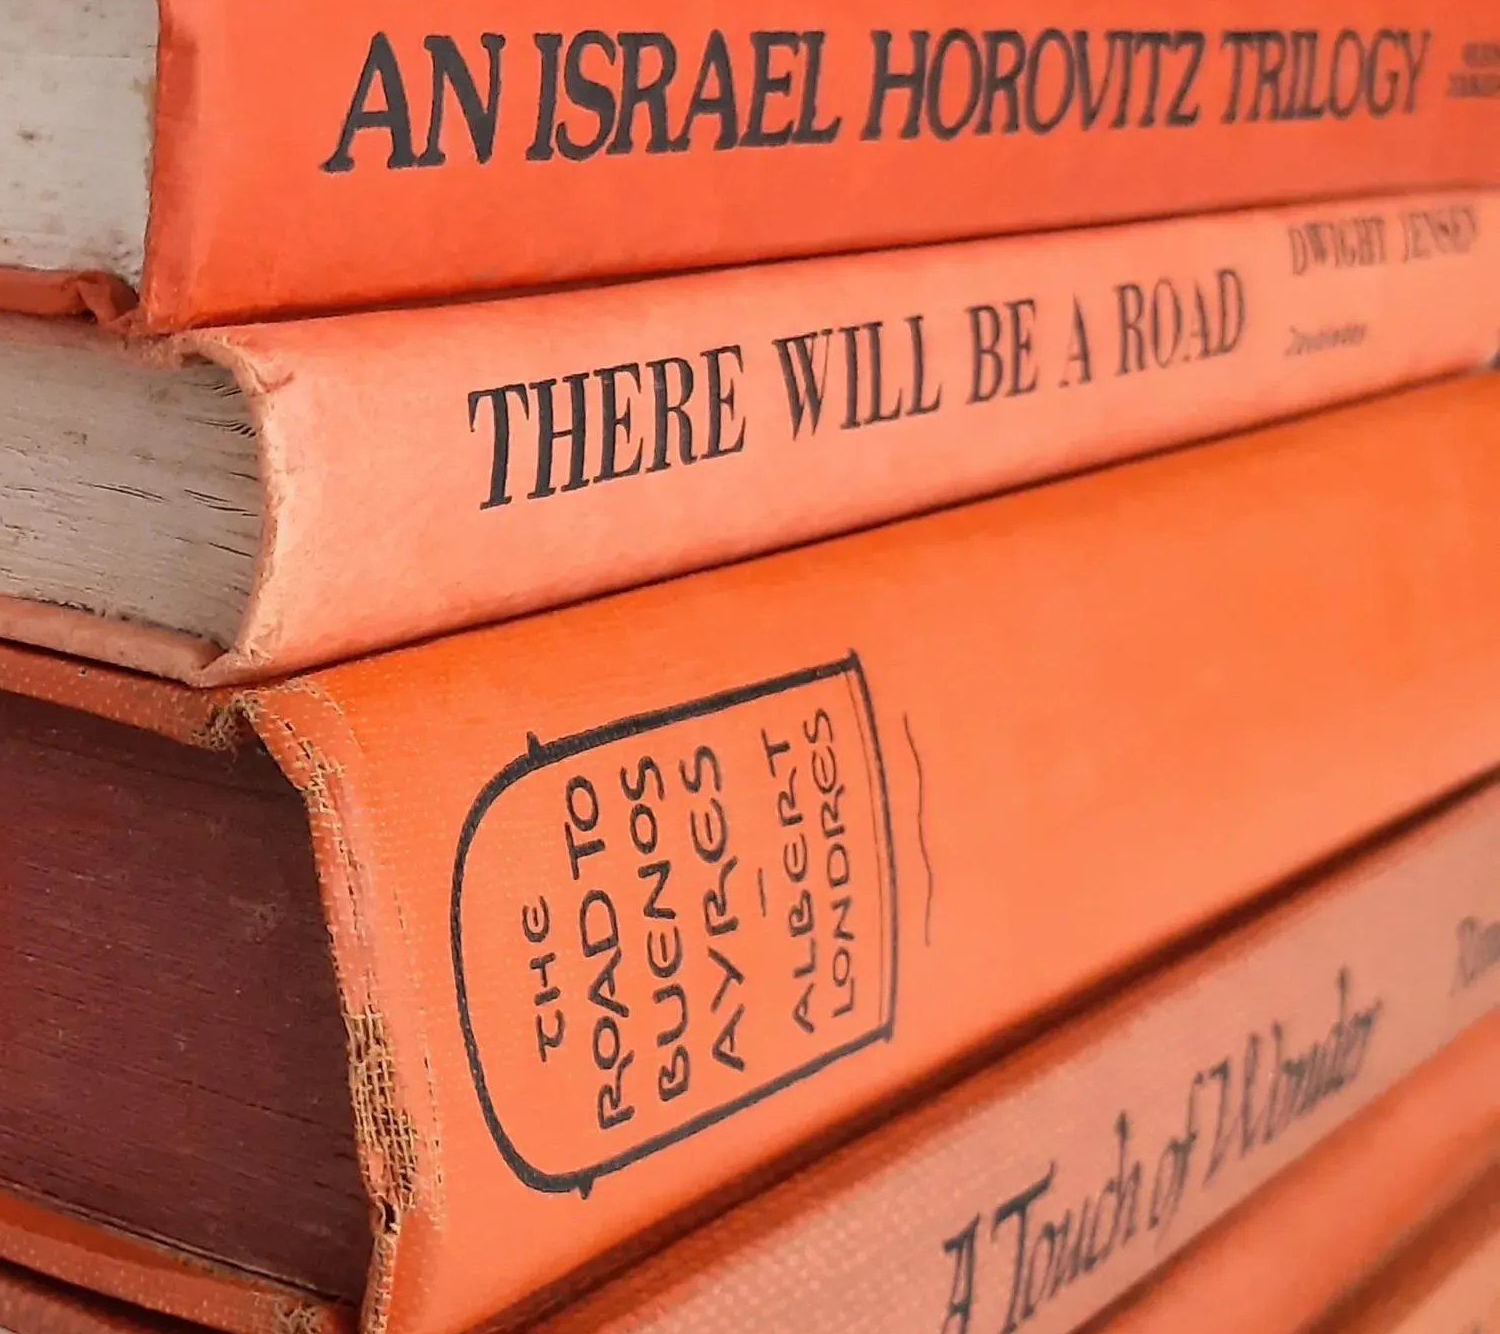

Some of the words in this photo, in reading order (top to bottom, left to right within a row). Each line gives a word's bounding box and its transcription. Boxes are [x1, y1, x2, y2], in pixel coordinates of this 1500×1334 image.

[318, 30, 506, 174] AN
[525, 29, 843, 162] ISRAEL
[860, 27, 1205, 141] HOROVITZ
[1220, 28, 1432, 124] TRILOGY
[1287, 215, 1389, 277] DWIGHT
[467, 344, 747, 511] THERE
[771, 315, 942, 442] WILL
[964, 299, 1040, 405] BE
[1058, 292, 1092, 389] A
[1114, 267, 1247, 376] ROAD
[564, 774, 607, 881] TO
[620, 754, 691, 1103] BUENOS
[680, 744, 745, 1072] AYRES
[761, 728, 817, 1034] ALBERT
[803, 707, 856, 1019] LONDRES
[522, 894, 566, 1062] THE
[579, 889, 635, 1131] ROAD
[1148, 1072, 1204, 1250] of
[1203, 963, 1382, 1185] Wonder
